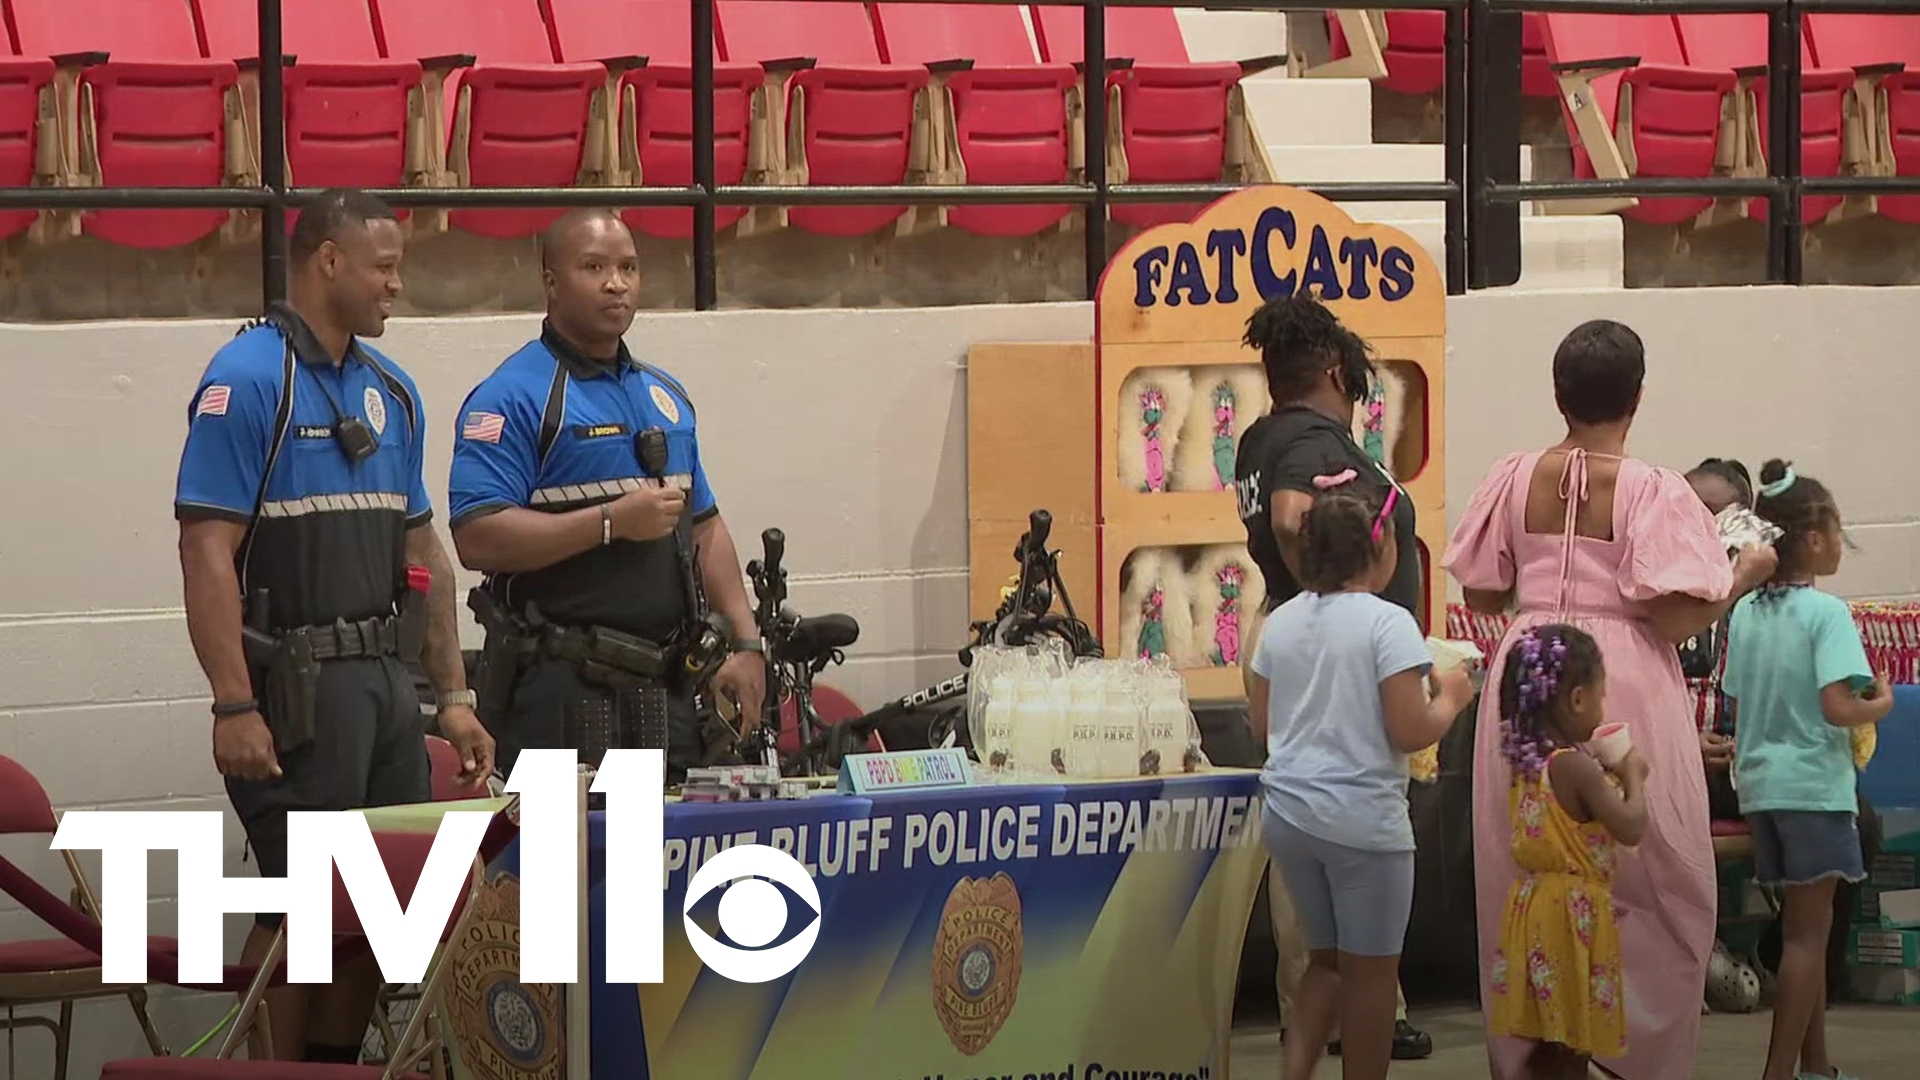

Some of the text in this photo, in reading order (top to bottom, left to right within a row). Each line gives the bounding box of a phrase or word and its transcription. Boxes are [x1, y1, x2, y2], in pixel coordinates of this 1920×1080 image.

[903, 673, 966, 707] POLICE
[866, 758, 895, 785] PBPD
[917, 754, 956, 782] PATROL
[769, 817, 893, 883] BLUFF
[903, 804, 1041, 869] POLICE
[1051, 796, 1264, 857] DEPARTMEN
[952, 907, 1010, 929] POLICE
[462, 924, 520, 950] OLIC
